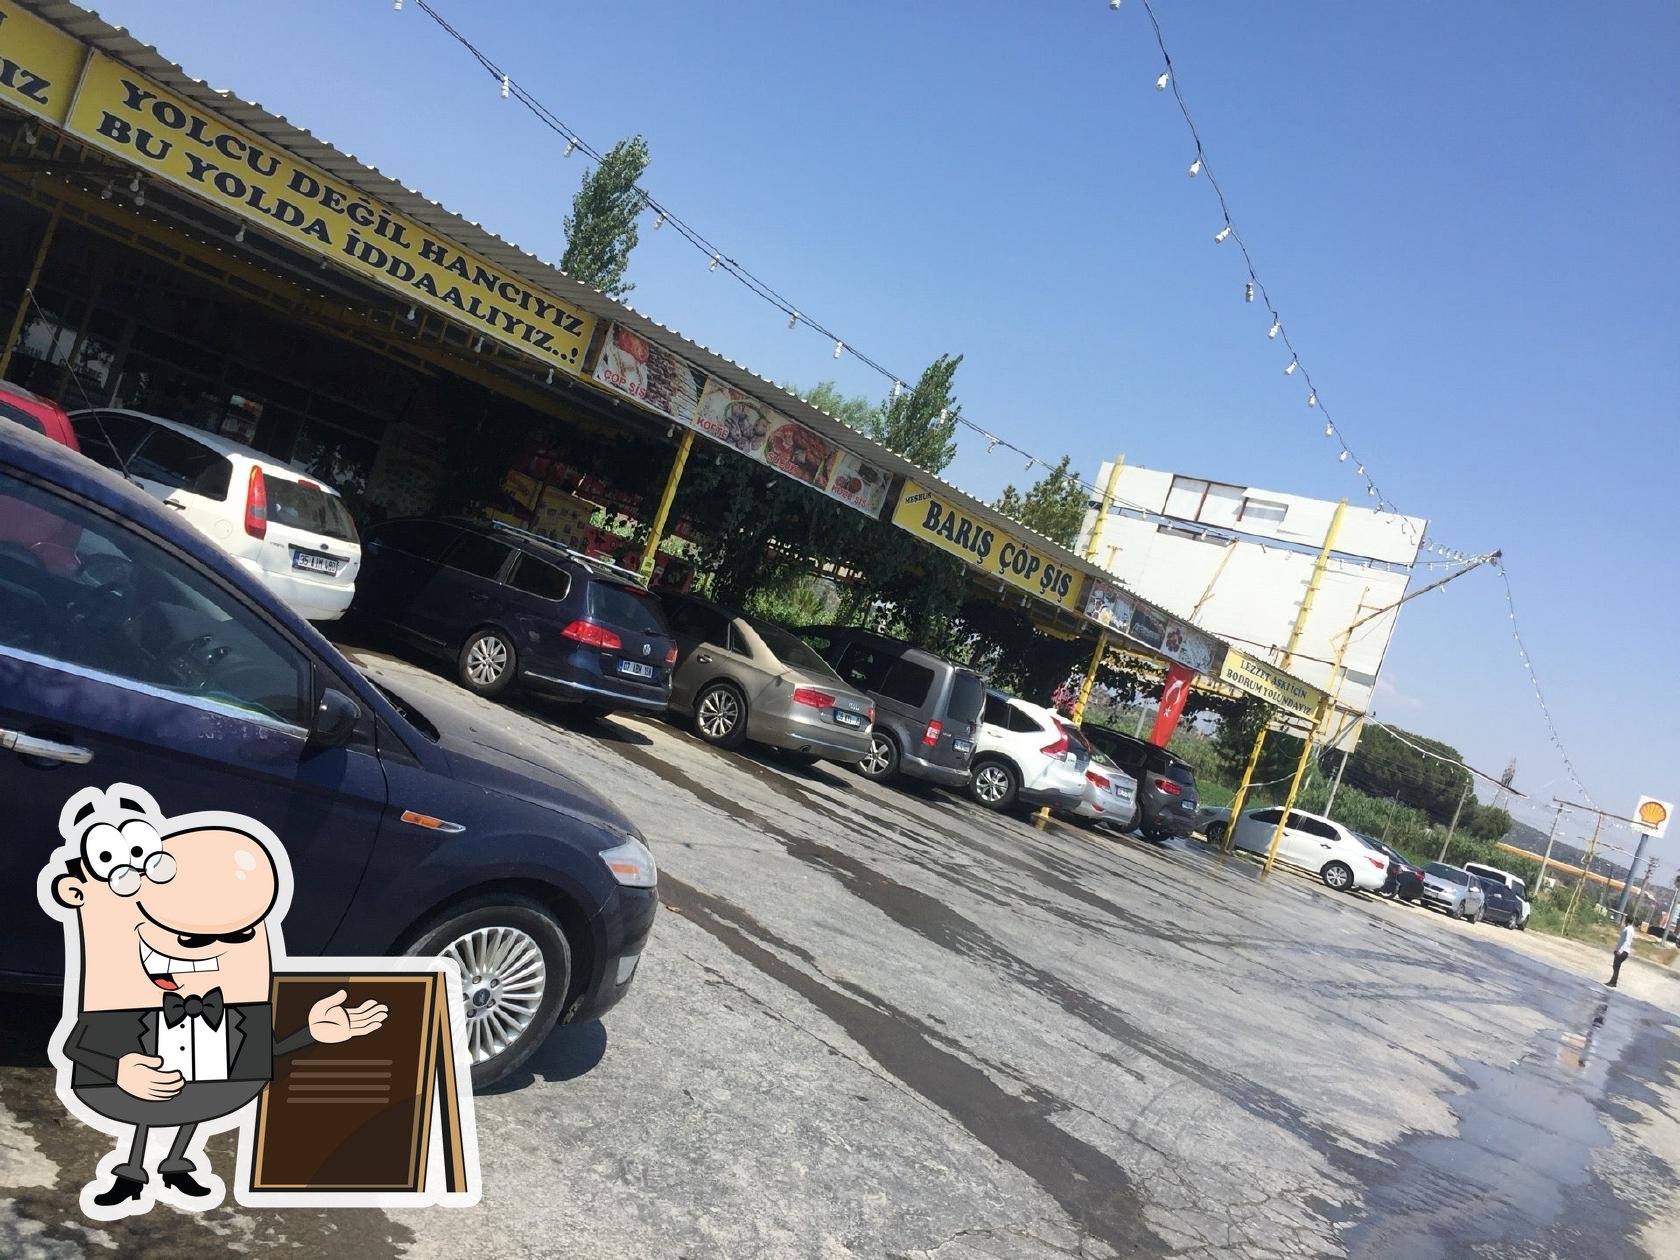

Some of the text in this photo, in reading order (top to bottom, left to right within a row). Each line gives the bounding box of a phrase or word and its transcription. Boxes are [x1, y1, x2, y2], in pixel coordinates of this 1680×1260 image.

[0, 55, 51, 105] IZ
[96, 110, 173, 161] BU
[185, 152, 333, 245] YOLDA
[120, 79, 584, 338] YOLCU DEĞİL HANCIYIZ
[922, 500, 1073, 603] BARIŞ ÇÖP ŞİŞ
[1226, 668, 1263, 694] BODRUM
[1240, 660, 1271, 682] LEZZET
